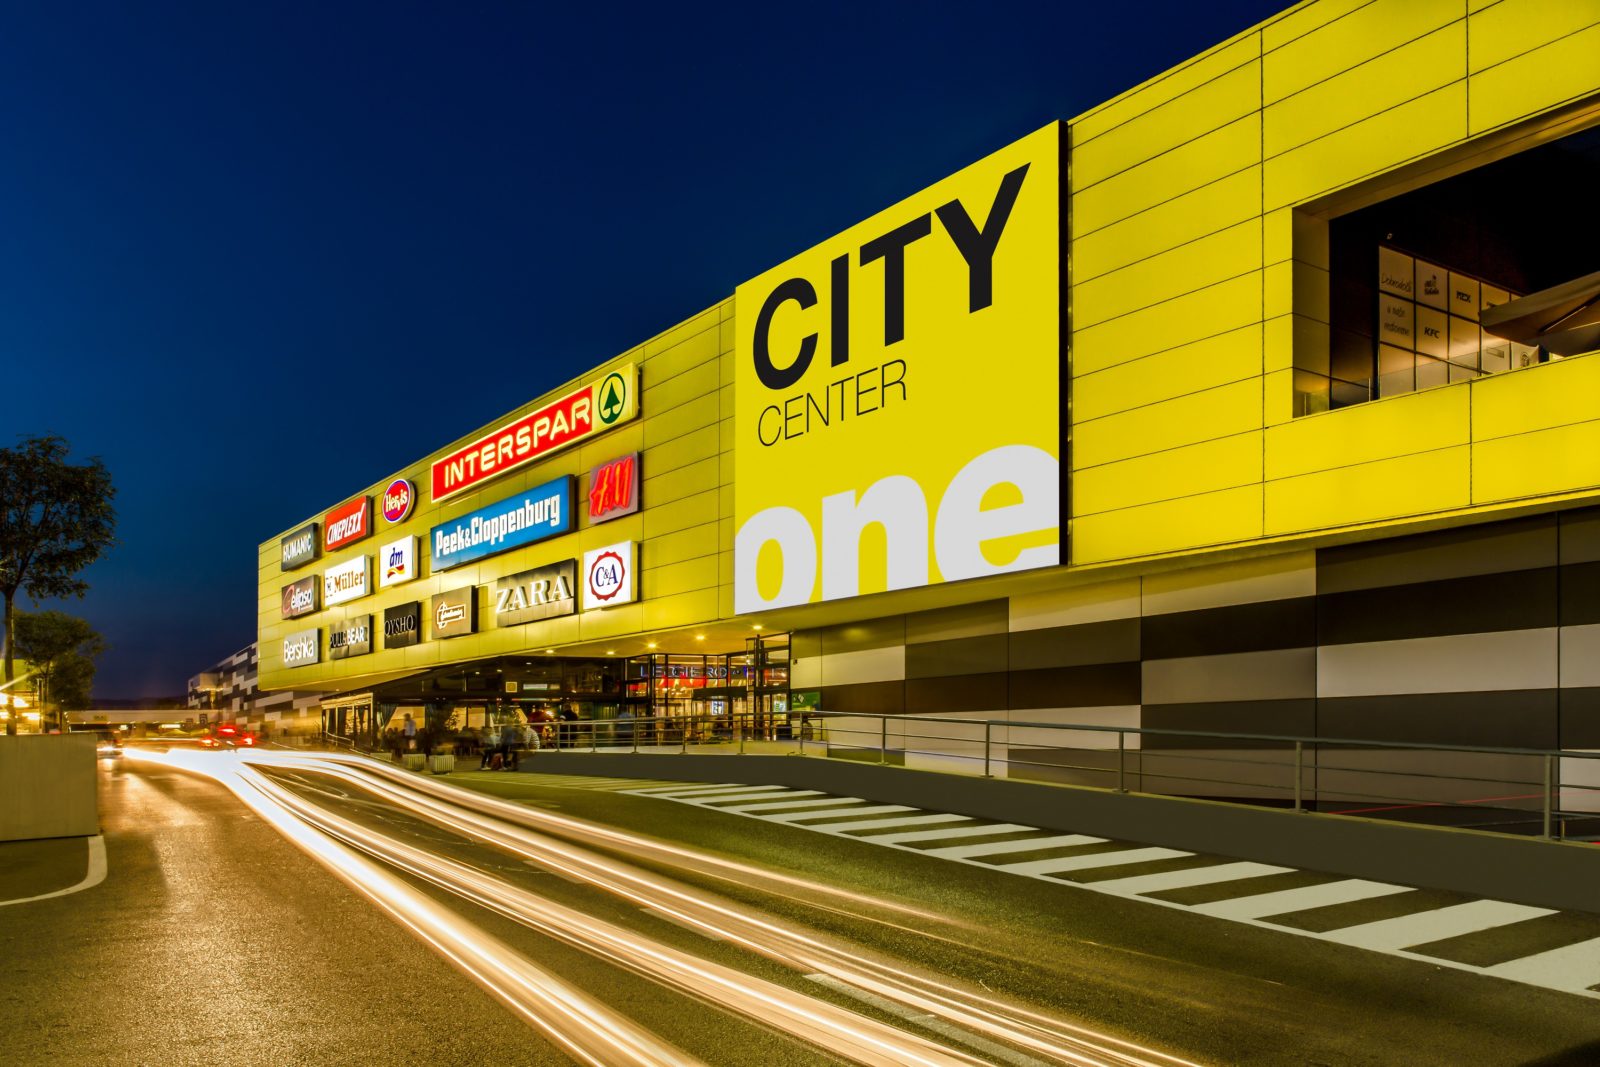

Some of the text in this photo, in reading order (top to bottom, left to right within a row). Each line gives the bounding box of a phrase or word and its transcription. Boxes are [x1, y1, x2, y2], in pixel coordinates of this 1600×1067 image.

[753, 162, 1031, 390] CITY
[1424, 327, 1439, 339] KFC
[758, 359, 907, 447] CENTER
[444, 396, 591, 489] INTERSPAR
[386, 490, 408, 511] Hervis
[327, 502, 366, 545] CINEPLEXX
[735, 444, 1060, 615] one
[283, 533, 312, 562] HUMANIC
[390, 548, 403, 567] dm
[334, 569, 365, 593] Müller
[595, 564, 618, 588] C&A
[495, 575, 571, 614] ZARA
[384, 614, 414, 636] OYSHO
[283, 634, 314, 664] Bershka
